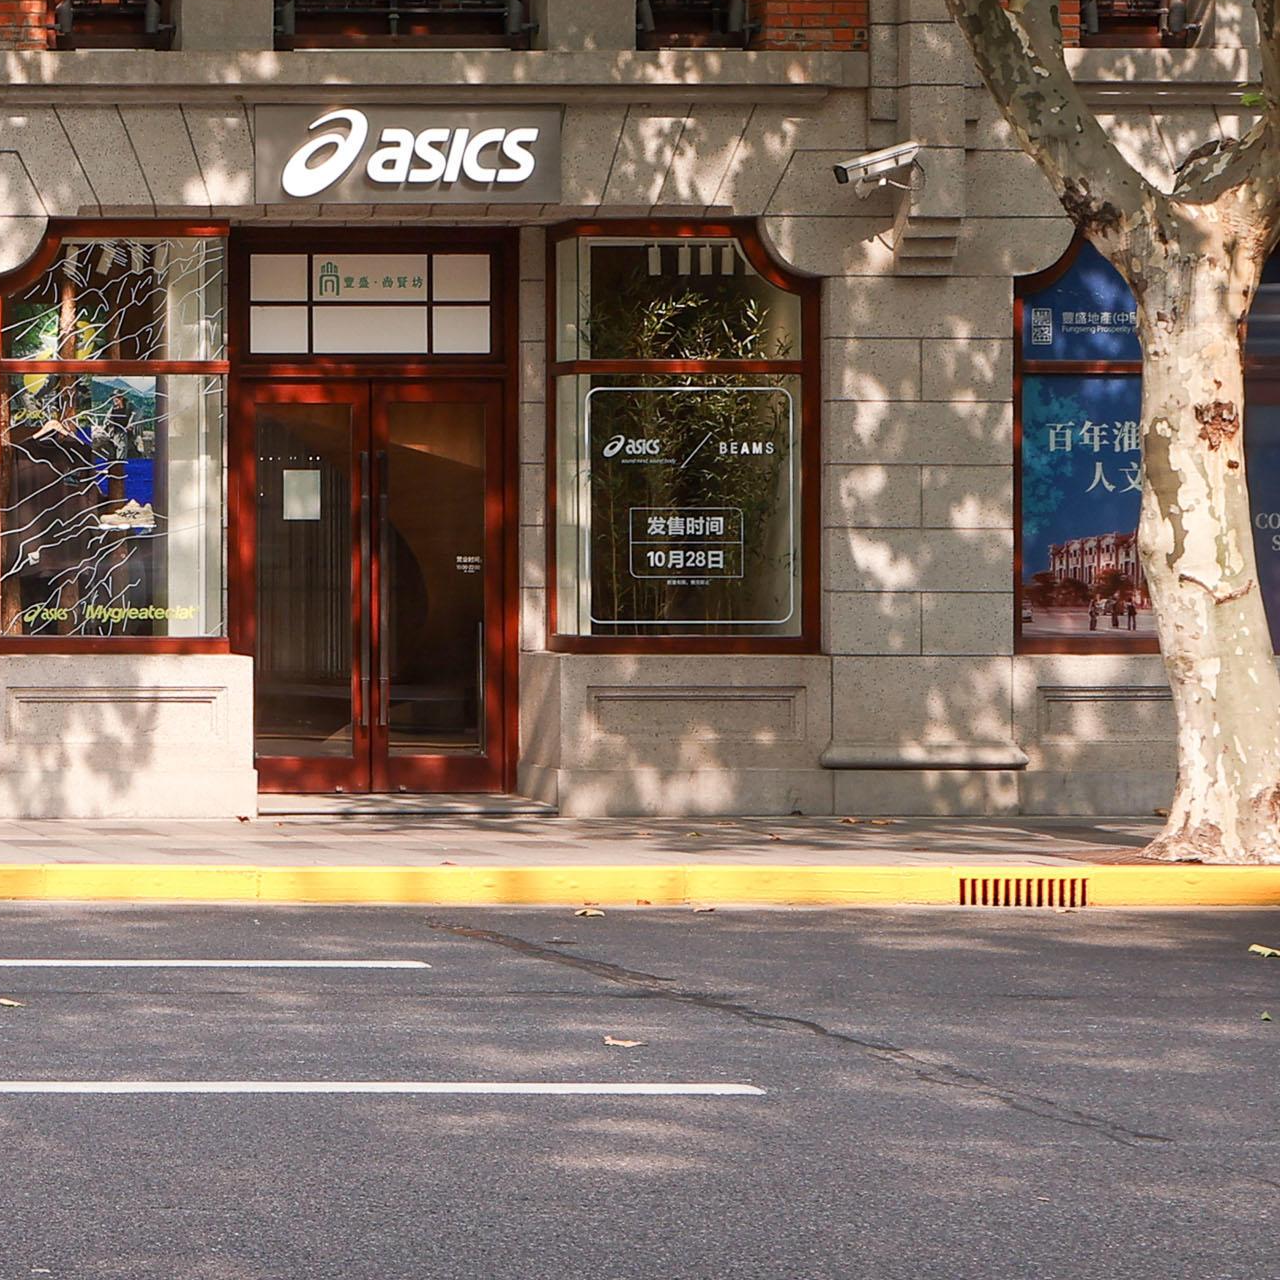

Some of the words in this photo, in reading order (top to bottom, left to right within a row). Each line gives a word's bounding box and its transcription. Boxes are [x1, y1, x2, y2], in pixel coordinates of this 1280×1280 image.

[367, 128, 539, 183] asics
[719, 442, 774, 455] BEAMS
[647, 516, 724, 536] 发售时间
[646, 551, 724, 568] 10月28日
